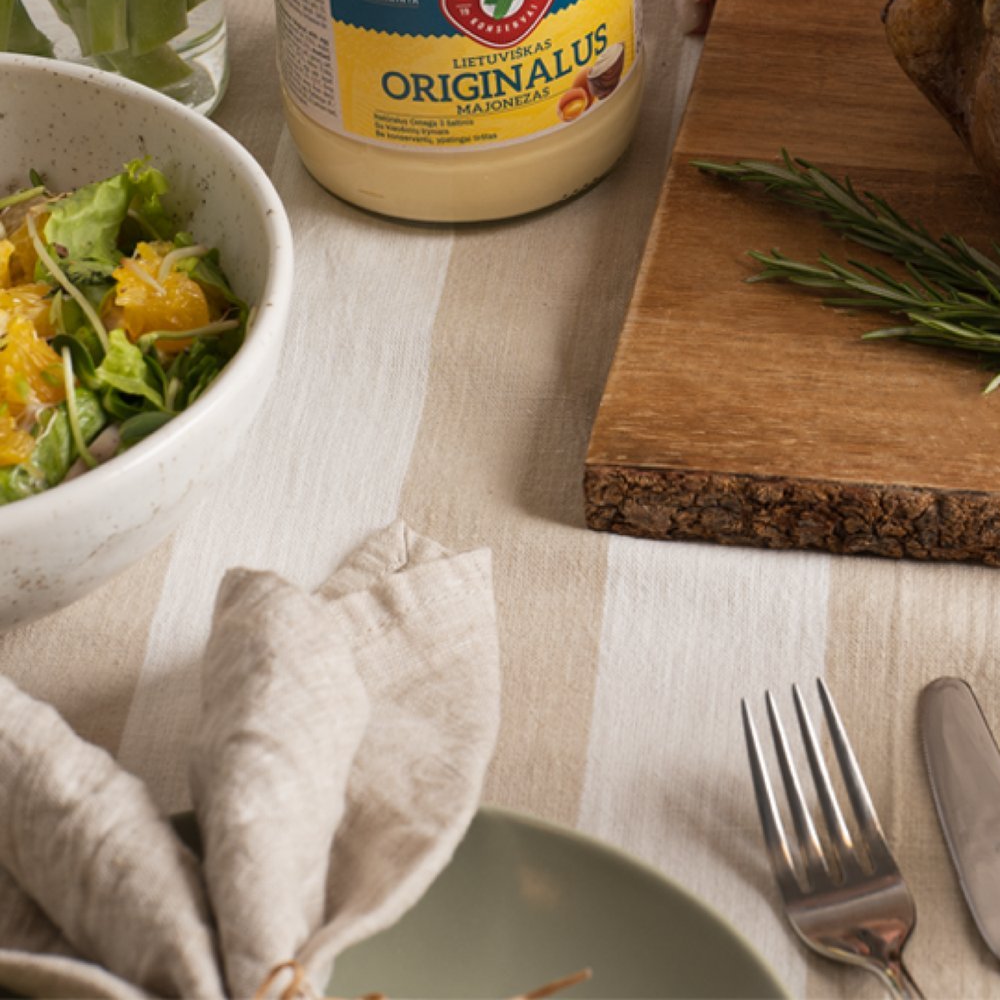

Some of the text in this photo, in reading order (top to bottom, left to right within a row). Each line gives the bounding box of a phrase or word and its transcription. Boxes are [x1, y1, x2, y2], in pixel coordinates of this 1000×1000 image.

[381, 23, 608, 103] ORIGINALUS
[453, 38, 552, 69] LIETUVIŠKAS
[456, 87, 550, 115] MAJONEZAS
